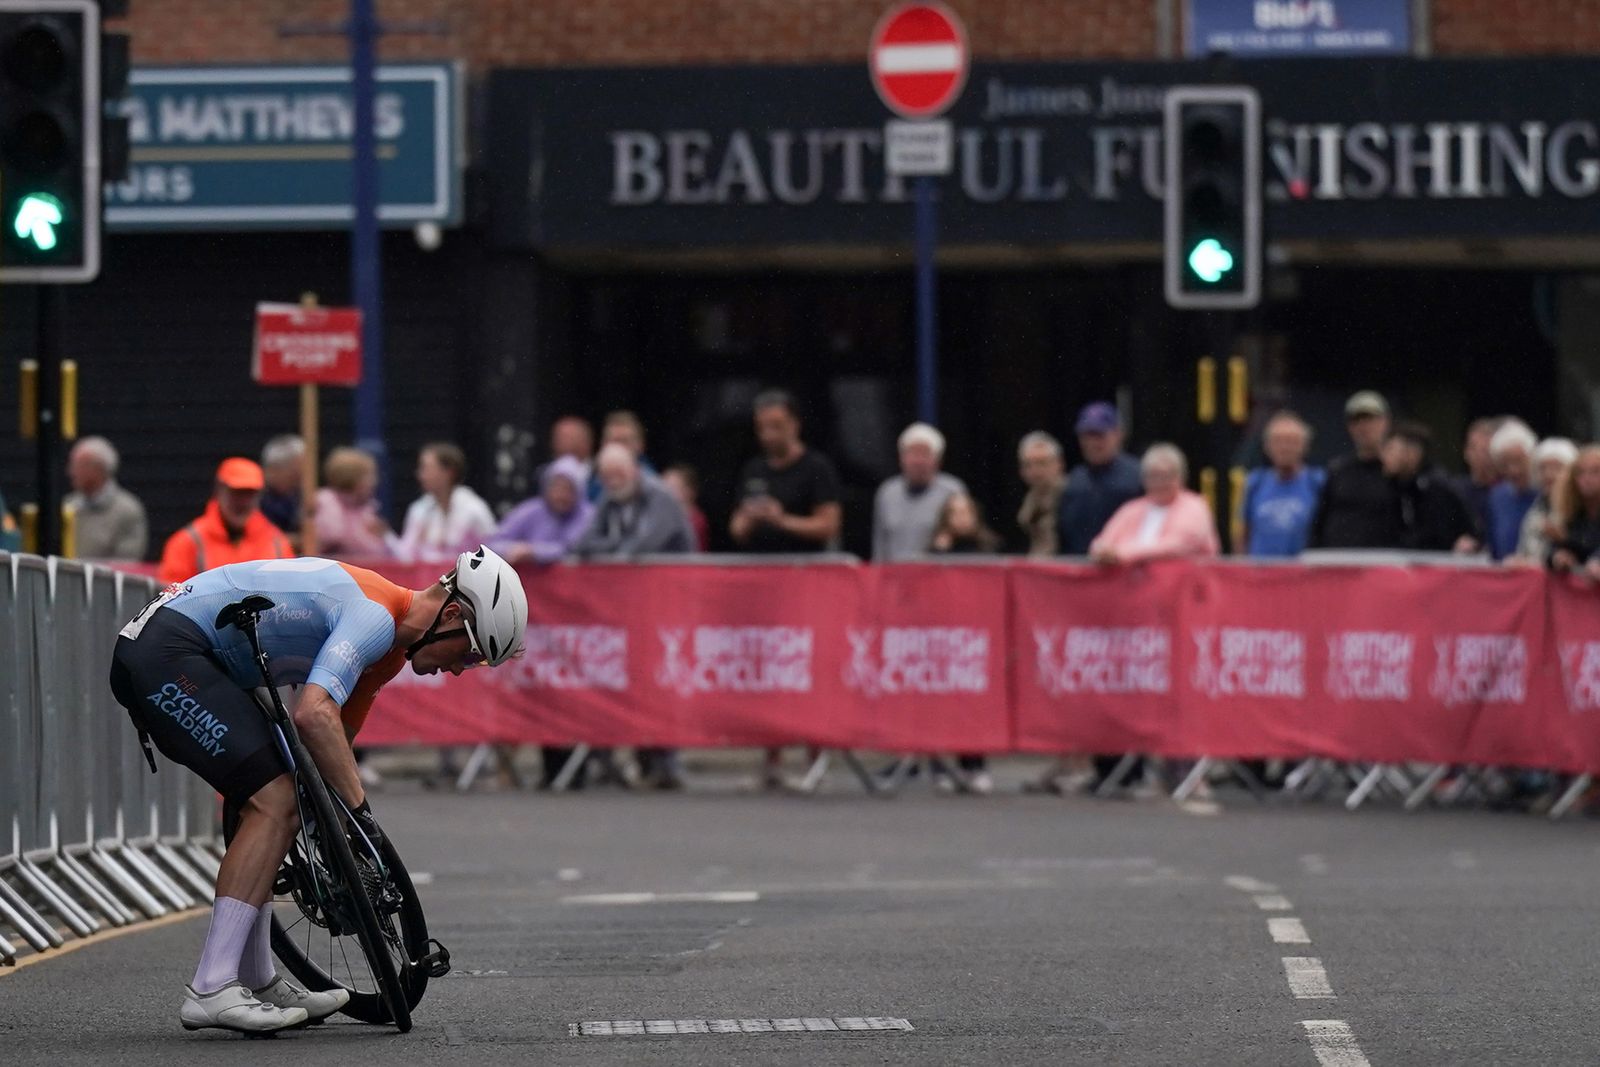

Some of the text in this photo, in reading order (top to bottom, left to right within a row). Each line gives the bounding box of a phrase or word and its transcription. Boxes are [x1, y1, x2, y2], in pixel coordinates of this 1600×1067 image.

[610, 121, 1599, 202] BEAUTUL FNISHING
[694, 627, 812, 657] BRITISH
[883, 627, 989, 656] BRITISH
[1065, 627, 1170, 657] BRITISH
[176, 673, 199, 696] THE
[694, 657, 812, 690] CYCLING
[880, 656, 989, 691] CYCLING
[1061, 657, 1170, 691] CYCLING
[146, 692, 226, 757] ACADEMY
[161, 683, 228, 739] CYCLING
